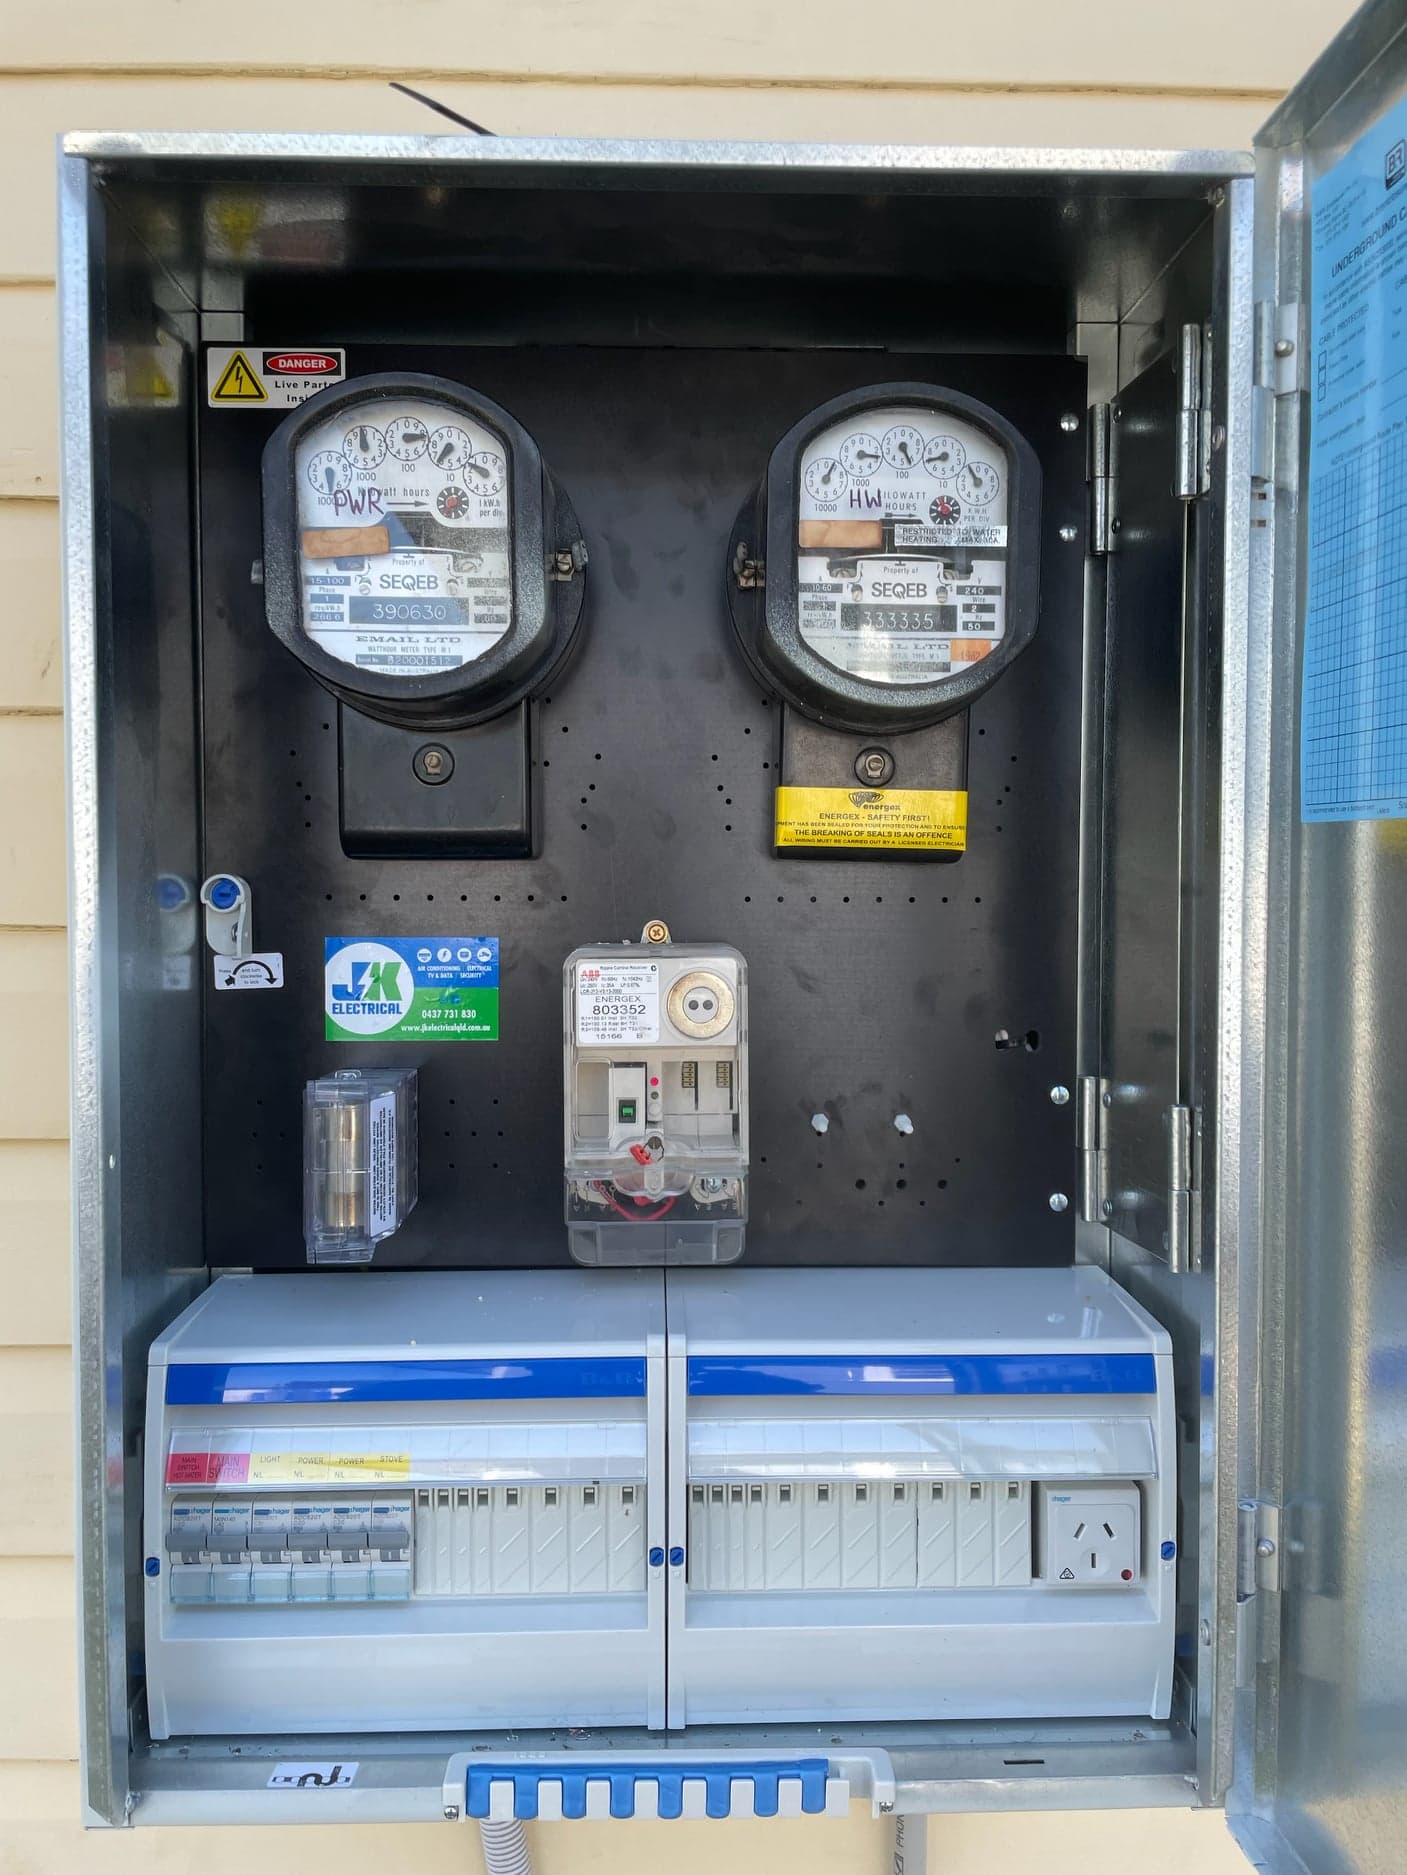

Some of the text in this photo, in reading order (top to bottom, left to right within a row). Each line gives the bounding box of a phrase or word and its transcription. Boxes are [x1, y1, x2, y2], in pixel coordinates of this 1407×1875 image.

[1332, 214, 1397, 277] UNDERGROUND
[278, 360, 326, 368] DANGER
[402, 464, 415, 472] 100
[896, 471, 909, 479] 100
[404, 488, 430, 496] hours
[884, 491, 926, 499] ILOWATT
[333, 487, 384, 516] PWR
[850, 488, 882, 509] HW
[815, 504, 837, 512] 10000
[886, 503, 917, 511] HOURS
[380, 575, 439, 590] SEQEB
[872, 583, 927, 599] SEQEB
[372, 605, 446, 619] 390630
[864, 612, 934, 630] 333335
[332, 962, 402, 1001] JK
[332, 1003, 402, 1014] ELECTRICAL
[422, 1010, 476, 1018] 0437 731 830
[593, 1005, 646, 1015] 803352
[217, 1456, 240, 1466] MAIN
[208, 1468, 244, 1479] SWITCH
[896, 1815, 904, 1848] PHON
